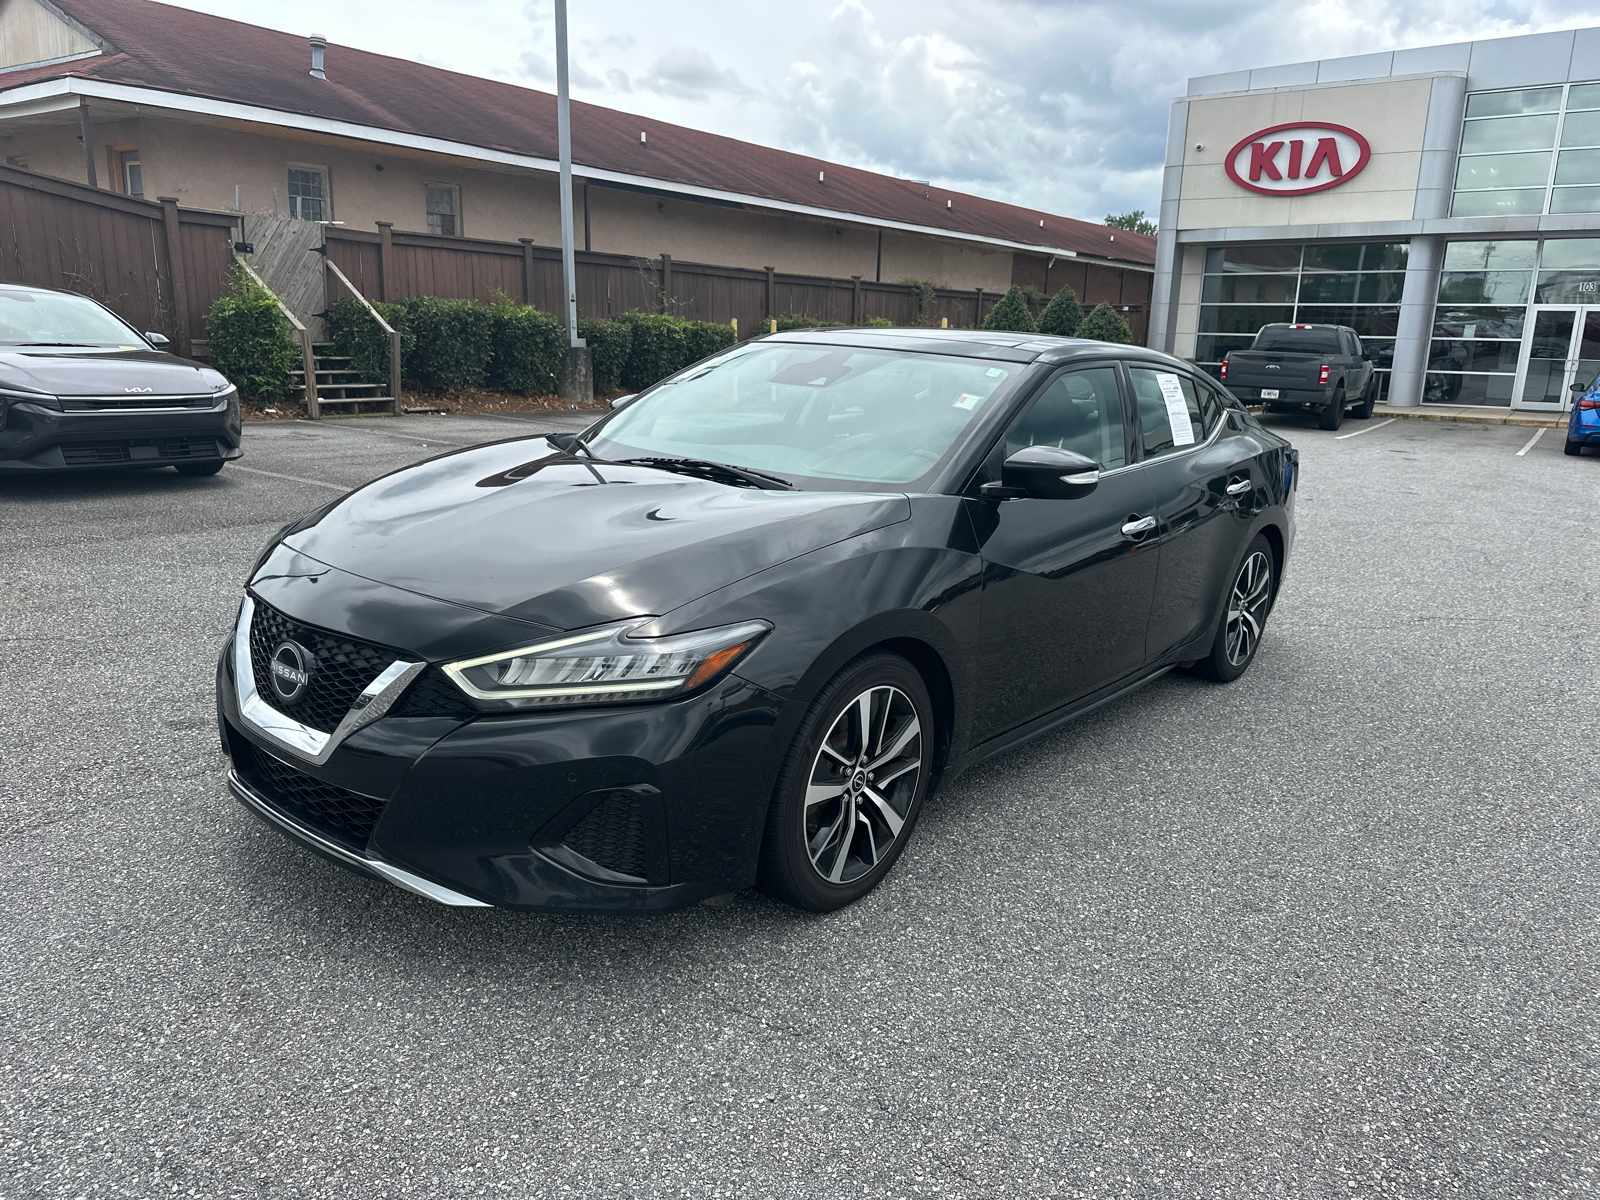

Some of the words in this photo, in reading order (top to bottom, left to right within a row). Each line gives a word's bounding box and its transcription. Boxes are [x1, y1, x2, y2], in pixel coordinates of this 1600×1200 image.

[1249, 138, 1343, 181] KIA
[1581, 282, 1595, 291] 103
[271, 660, 306, 684] NISSAN
